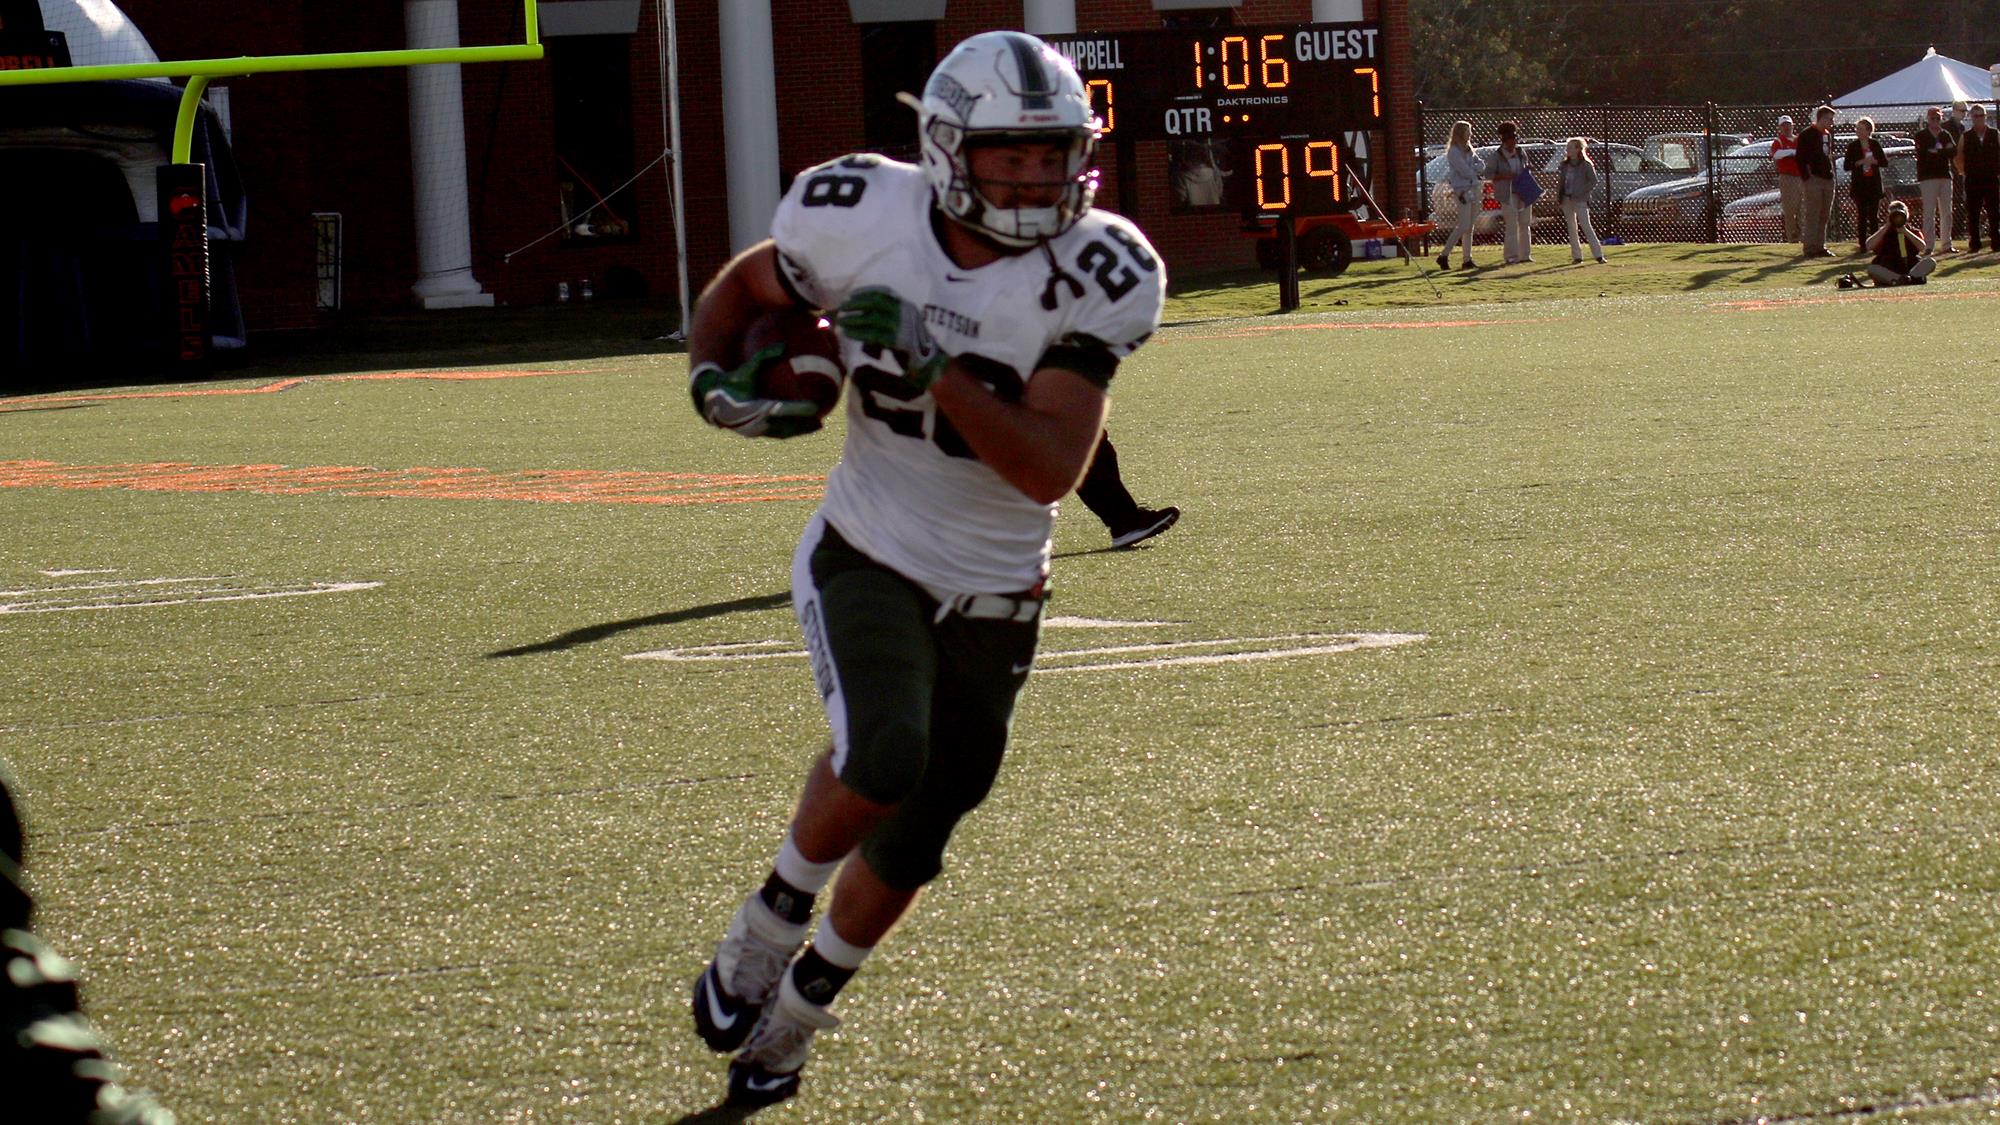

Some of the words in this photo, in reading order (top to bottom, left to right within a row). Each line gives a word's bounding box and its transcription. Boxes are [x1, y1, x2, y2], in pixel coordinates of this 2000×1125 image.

[1050, 39, 1125, 71] AMPBELL
[1194, 34, 1290, 90] 1:06
[1295, 29, 1379, 63] GUEST
[1217, 95, 1289, 106] DAKTRONICS
[1353, 67, 1380, 118] 7
[1164, 107, 1213, 136] QTR
[1255, 140, 1339, 210] 09
